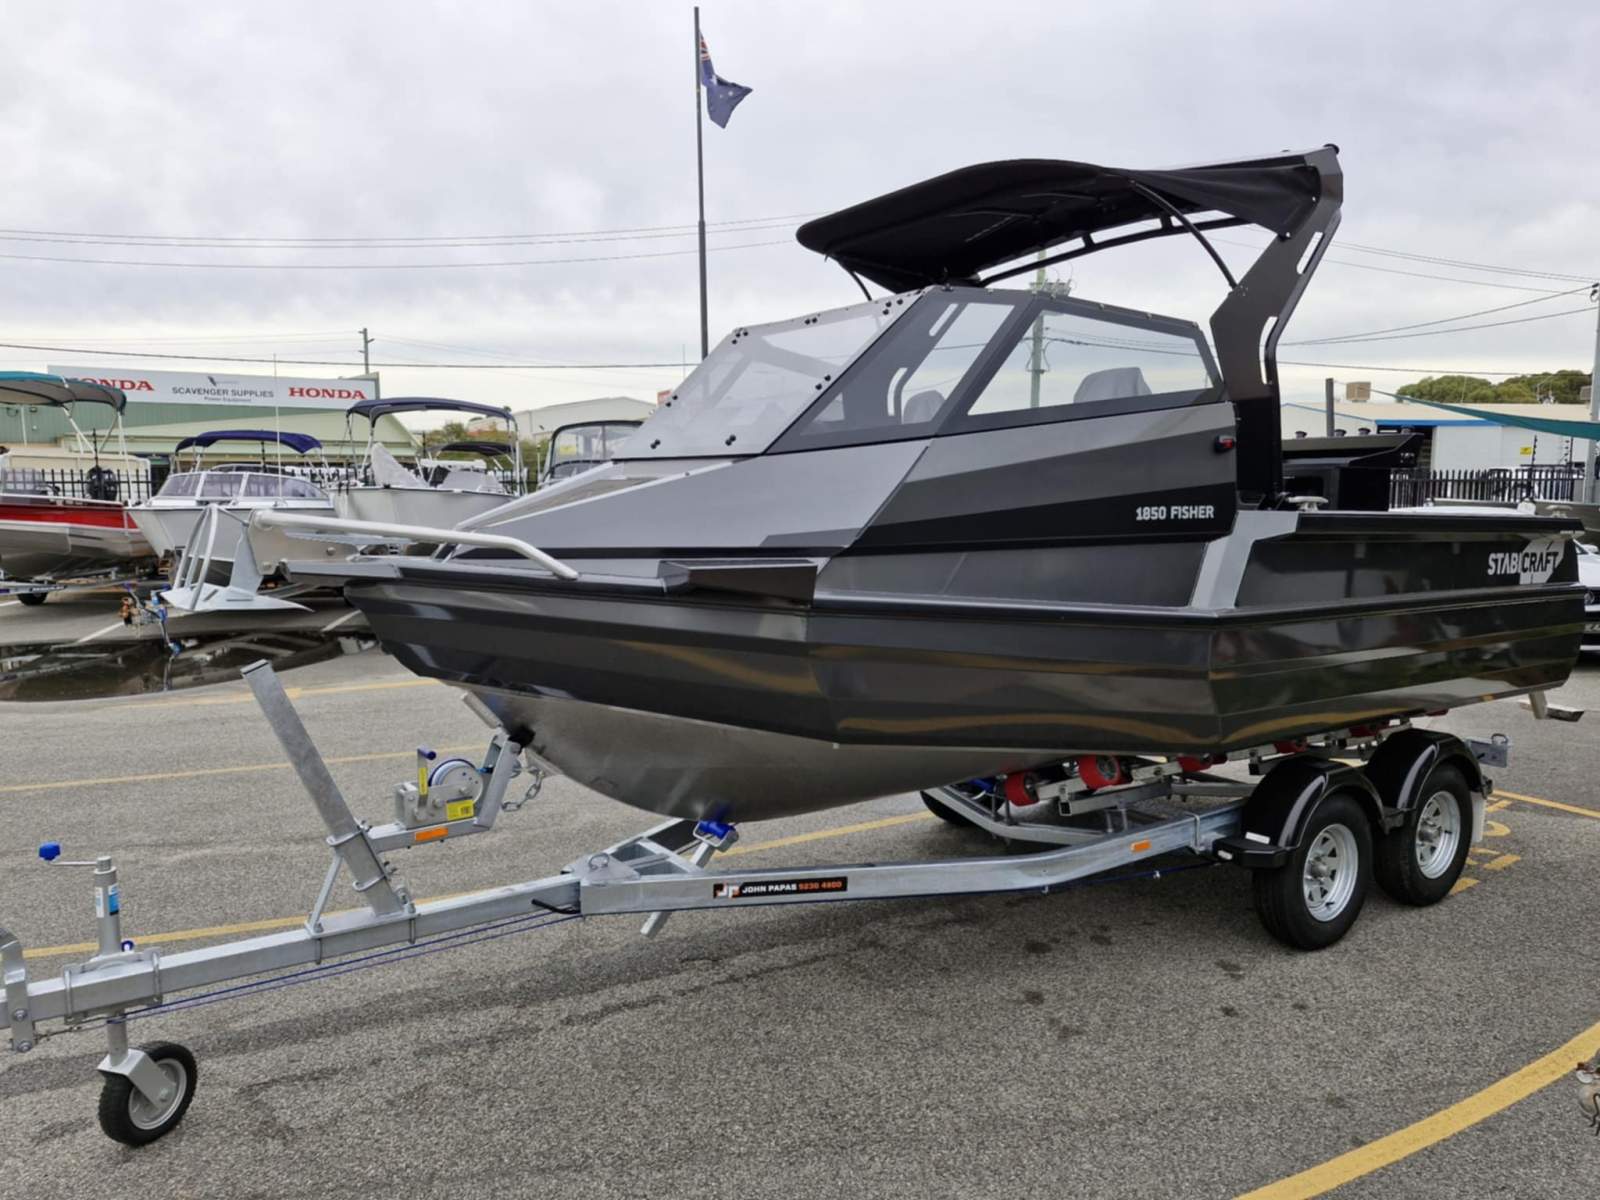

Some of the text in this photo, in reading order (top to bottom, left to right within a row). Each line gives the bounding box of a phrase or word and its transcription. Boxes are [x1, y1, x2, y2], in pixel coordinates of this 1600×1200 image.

[172, 386, 274, 398] SCAVENGER SUPPLIES
[288, 387, 366, 400] HONDA
[1135, 505, 1215, 521] 1850 FISHER
[1487, 551, 1559, 576] STABICRAFT
[742, 884, 767, 894] JOHN
[768, 883, 797, 892] PAPAS
